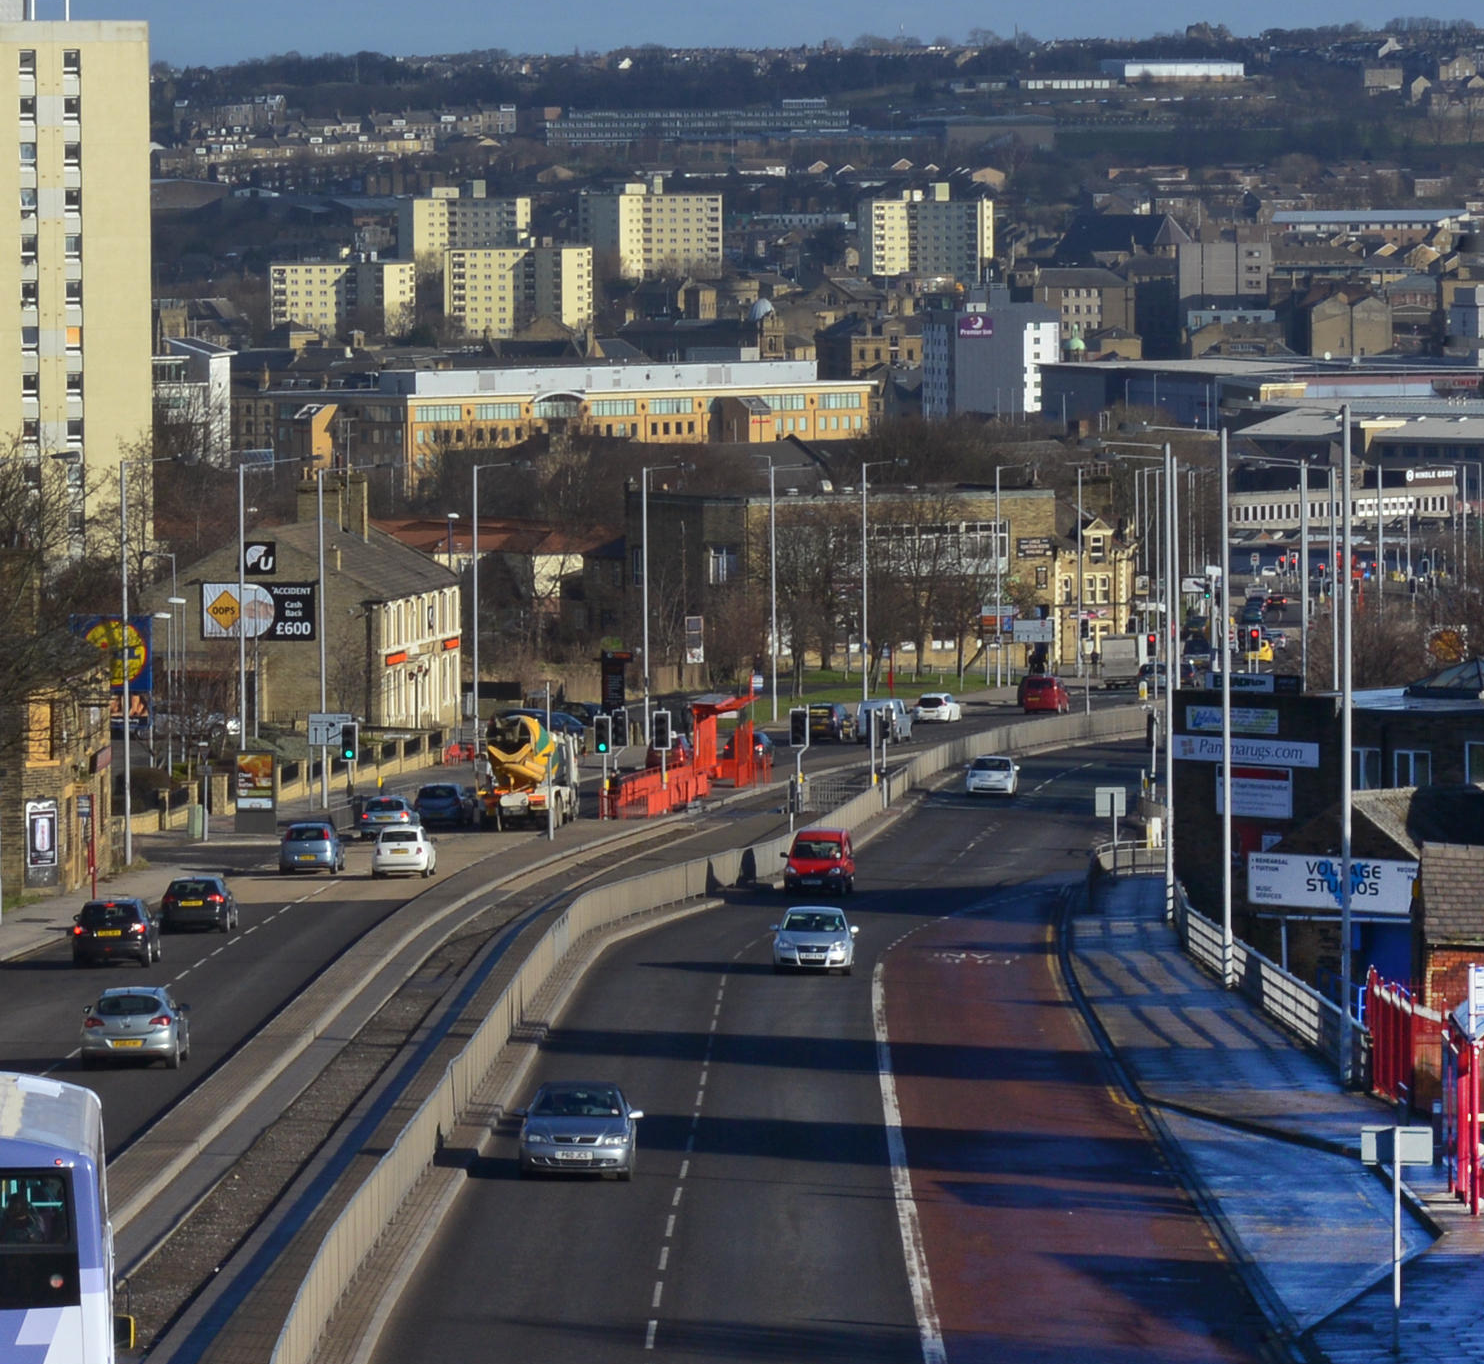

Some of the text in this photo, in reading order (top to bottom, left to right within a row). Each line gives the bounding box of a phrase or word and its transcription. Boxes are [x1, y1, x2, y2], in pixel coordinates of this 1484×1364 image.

[212, 606, 235, 615] OOPS
[276, 621, 311, 635] £600
[1198, 739, 1303, 761] Panmarugs.com
[1255, 892, 1282, 900] SERVICES
